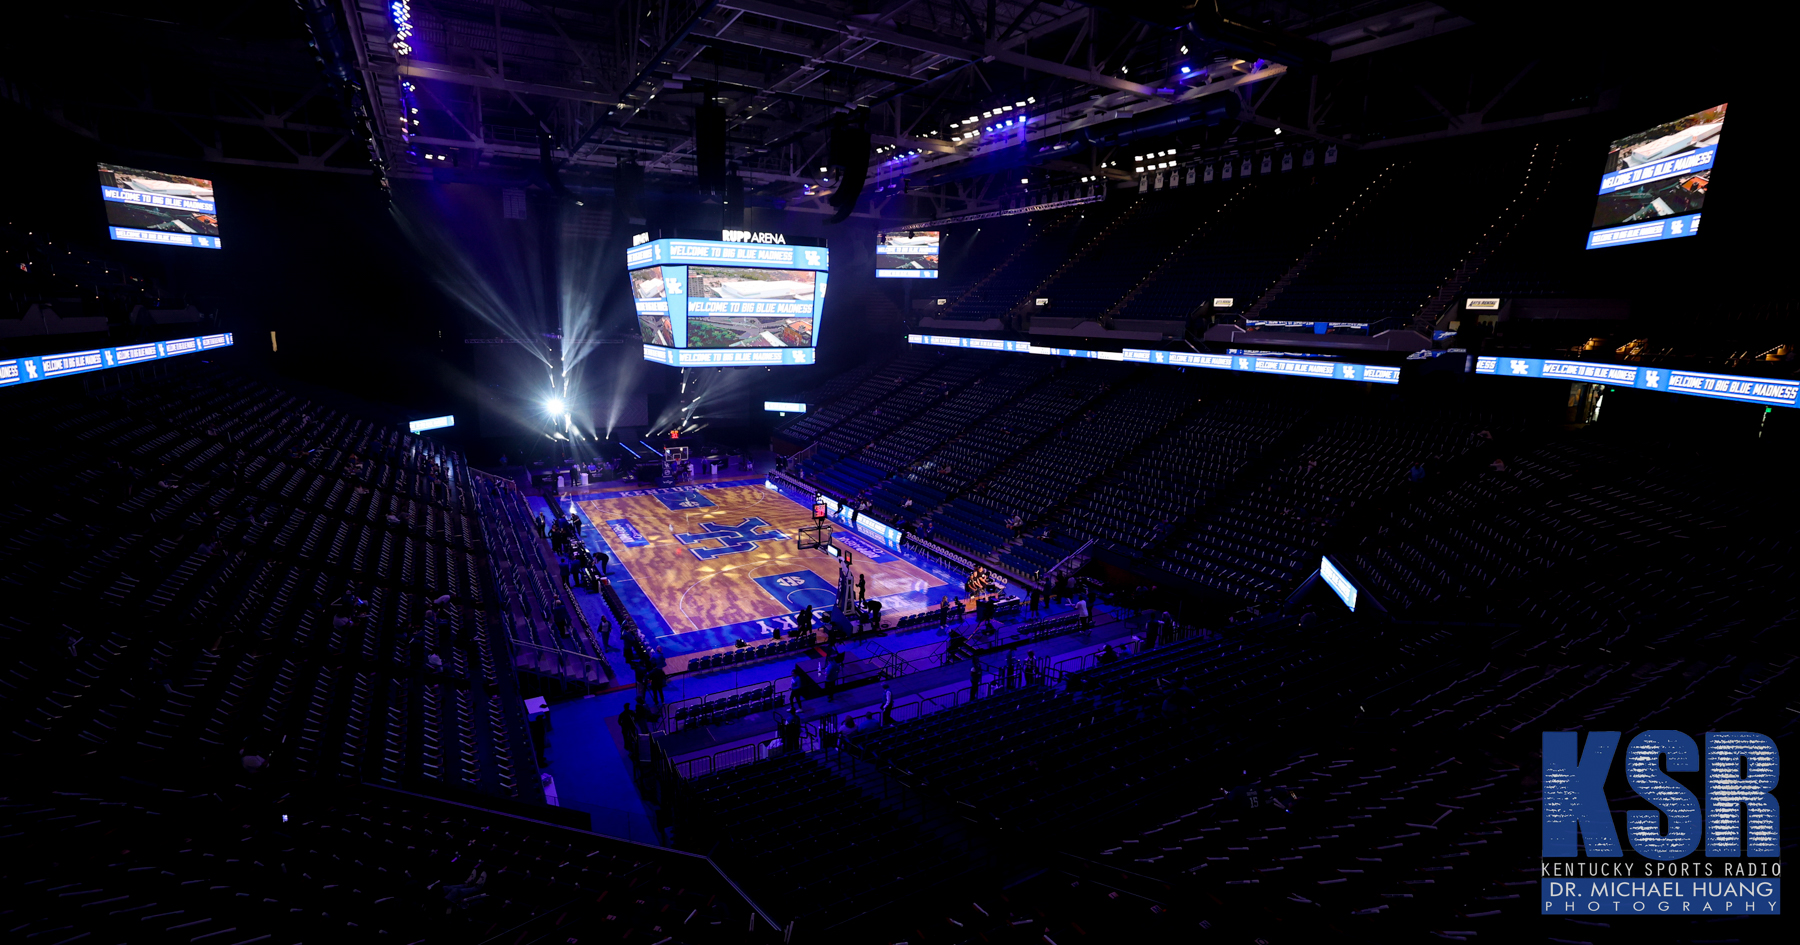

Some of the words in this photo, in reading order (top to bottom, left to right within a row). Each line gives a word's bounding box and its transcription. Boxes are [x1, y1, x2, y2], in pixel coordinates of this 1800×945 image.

[1601, 172, 1632, 190] WELCOME
[1631, 171, 1641, 182] TO
[1640, 166, 1655, 180] BIG
[1653, 160, 1675, 177] BLUE
[1673, 150, 1714, 171] MADNESS
[104, 189, 141, 202] WELCOME
[141, 194, 152, 203] TO
[152, 195, 164, 205] BIG
[164, 197, 182, 207] BLUE
[183, 199, 214, 211] MADNESS
[722, 229, 752, 243] RUPP
[751, 232, 786, 245] ARENA
[670, 245, 709, 257] WELCOME
[711, 247, 722, 257] TO
[722, 248, 736, 258] BIG
[737, 248, 757, 259] BLUE
[758, 250, 793, 261] MADNESS
[688, 301, 729, 313] WELCOME
[730, 302, 740, 313] TO
[741, 302, 755, 313] BIG
[756, 302, 776, 313] BLUE
[777, 303, 813, 314] MADNESS
[679, 353, 711, 362] WELCOME
[712, 353, 722, 362] TO
[723, 353, 734, 362] BIG
[735, 352, 752, 361] BLUE
[752, 351, 783, 361] MADNESS
[1255, 360, 1278, 369] WELCOME
[1285, 363, 1295, 371] BIG
[1295, 364, 1308, 372] BLUE
[1308, 365, 1334, 374] MADNESS
[1363, 369, 1392, 379] WELCOME
[1542, 363, 1578, 375] WELCOME
[1578, 367, 1586, 376] TO
[1585, 367, 1595, 377] BIG
[1594, 368, 1608, 378] BLUE
[1607, 369, 1637, 381] MADNESS
[1668, 375, 1705, 389] WELCOME
[1704, 378, 1716, 390] TO
[1715, 380, 1730, 392] BIG
[1729, 381, 1753, 394] BLUE
[1752, 384, 1799, 399] MADNESS
